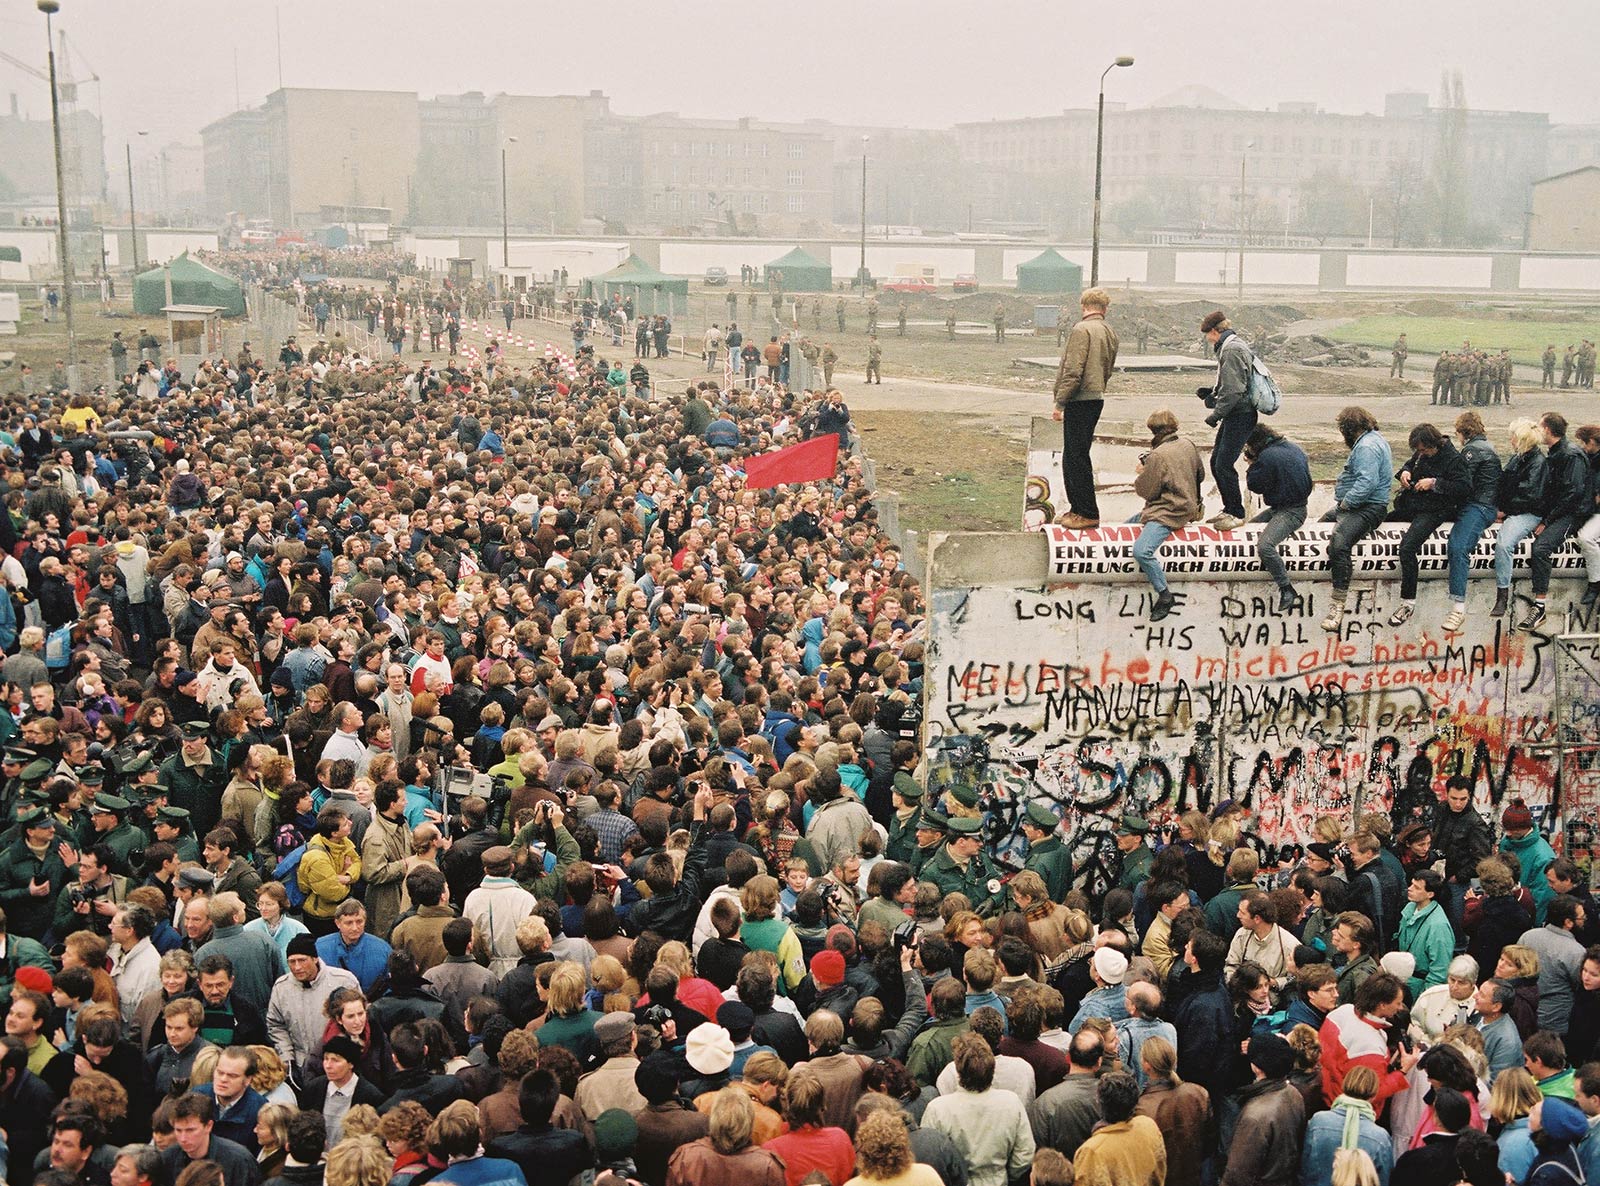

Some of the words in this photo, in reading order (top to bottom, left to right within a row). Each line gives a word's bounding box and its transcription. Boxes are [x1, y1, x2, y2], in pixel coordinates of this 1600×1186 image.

[1055, 545, 1097, 559] EINE
[1159, 545, 1209, 558] OHNE
[1214, 544, 1297, 558] MILIR.
[1298, 544, 1320, 557] ES
[1371, 543, 1401, 557] DIE
[1055, 561, 1135, 574] TEILUNG
[1138, 561, 1204, 573] RCH
[1360, 559, 1397, 571] DES
[1015, 599, 1096, 623] LONG
[1218, 620, 1309, 648] WALL
[1193, 645, 1289, 681] mich
[1296, 636, 1357, 671] alle
[1373, 630, 1465, 664] nicht
[1043, 677, 1194, 733] MANUELA
